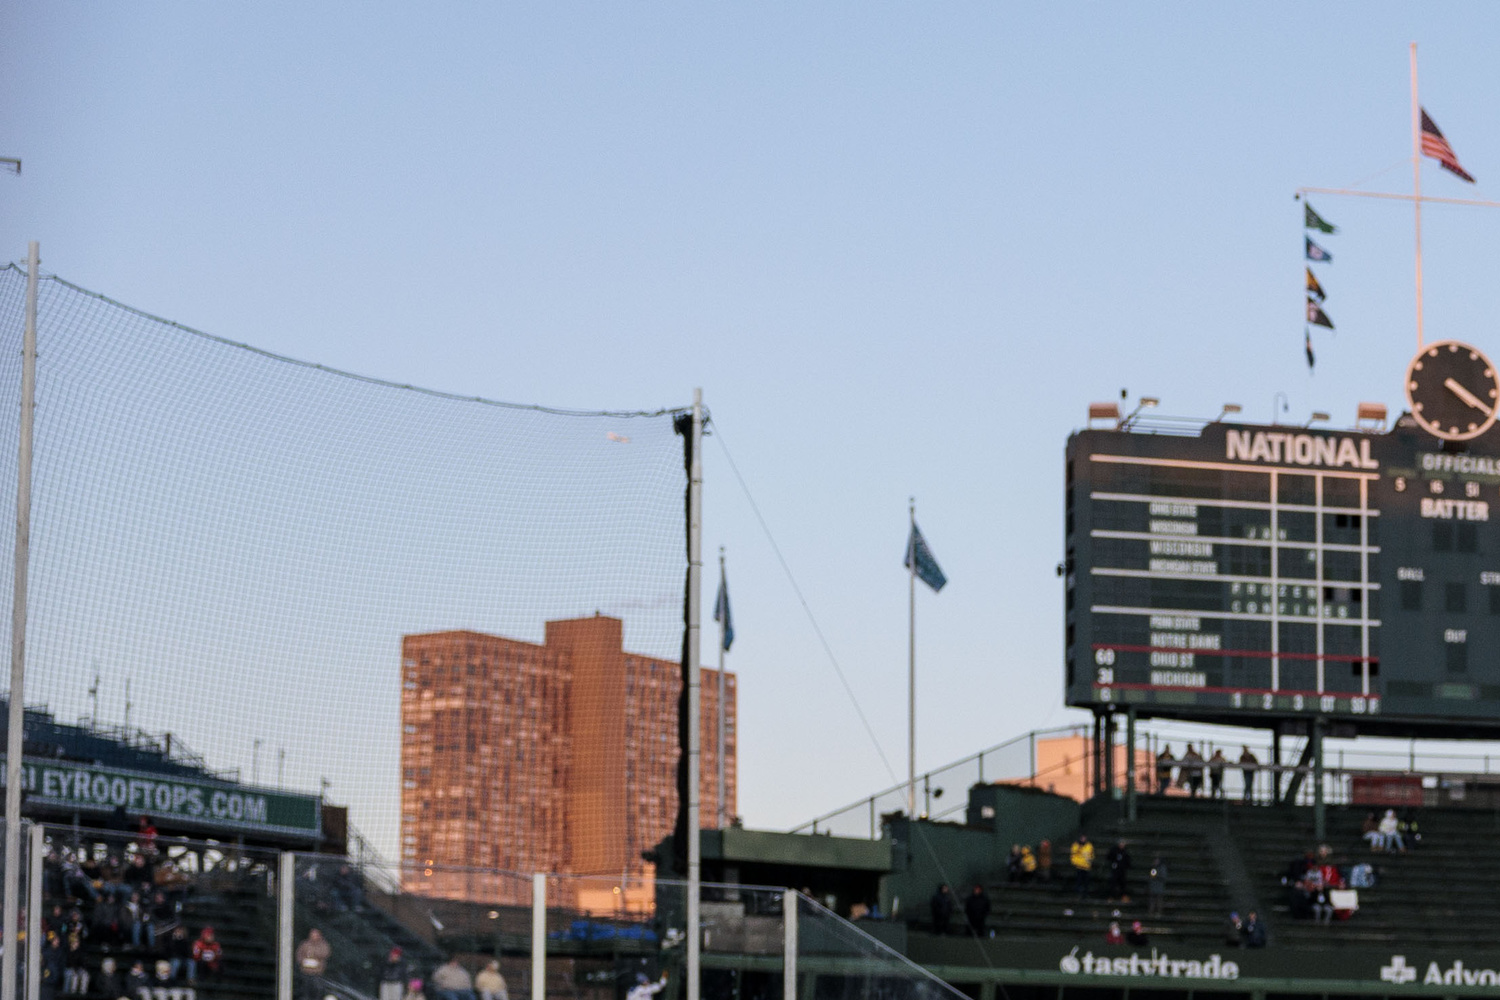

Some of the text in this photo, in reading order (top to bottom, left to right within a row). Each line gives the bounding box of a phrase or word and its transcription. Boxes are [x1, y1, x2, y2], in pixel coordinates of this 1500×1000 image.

[1226, 429, 1379, 469] NATIONAL
[1171, 503, 1198, 518] STATE
[1420, 497, 1489, 521] BATTER
[1150, 539, 1213, 557] WISCONSIN
[1192, 560, 1218, 575] STATE
[1397, 566, 1425, 581] BALL
[1231, 582, 1317, 600] FROZEN
[1231, 600, 1348, 619] CONFINES
[1150, 632, 1220, 650] NOTRE DAME
[1444, 628, 1467, 643] OUT
[1150, 650, 1195, 668] OHIO ST
[1097, 667, 1114, 684] 31
[1150, 670, 1206, 688] MICHIGAN
[1232, 691, 1241, 709] 1
[1263, 692, 1273, 710] 2
[1293, 693, 1304, 711] 3
[1082, 950, 1240, 980] tastytrade
